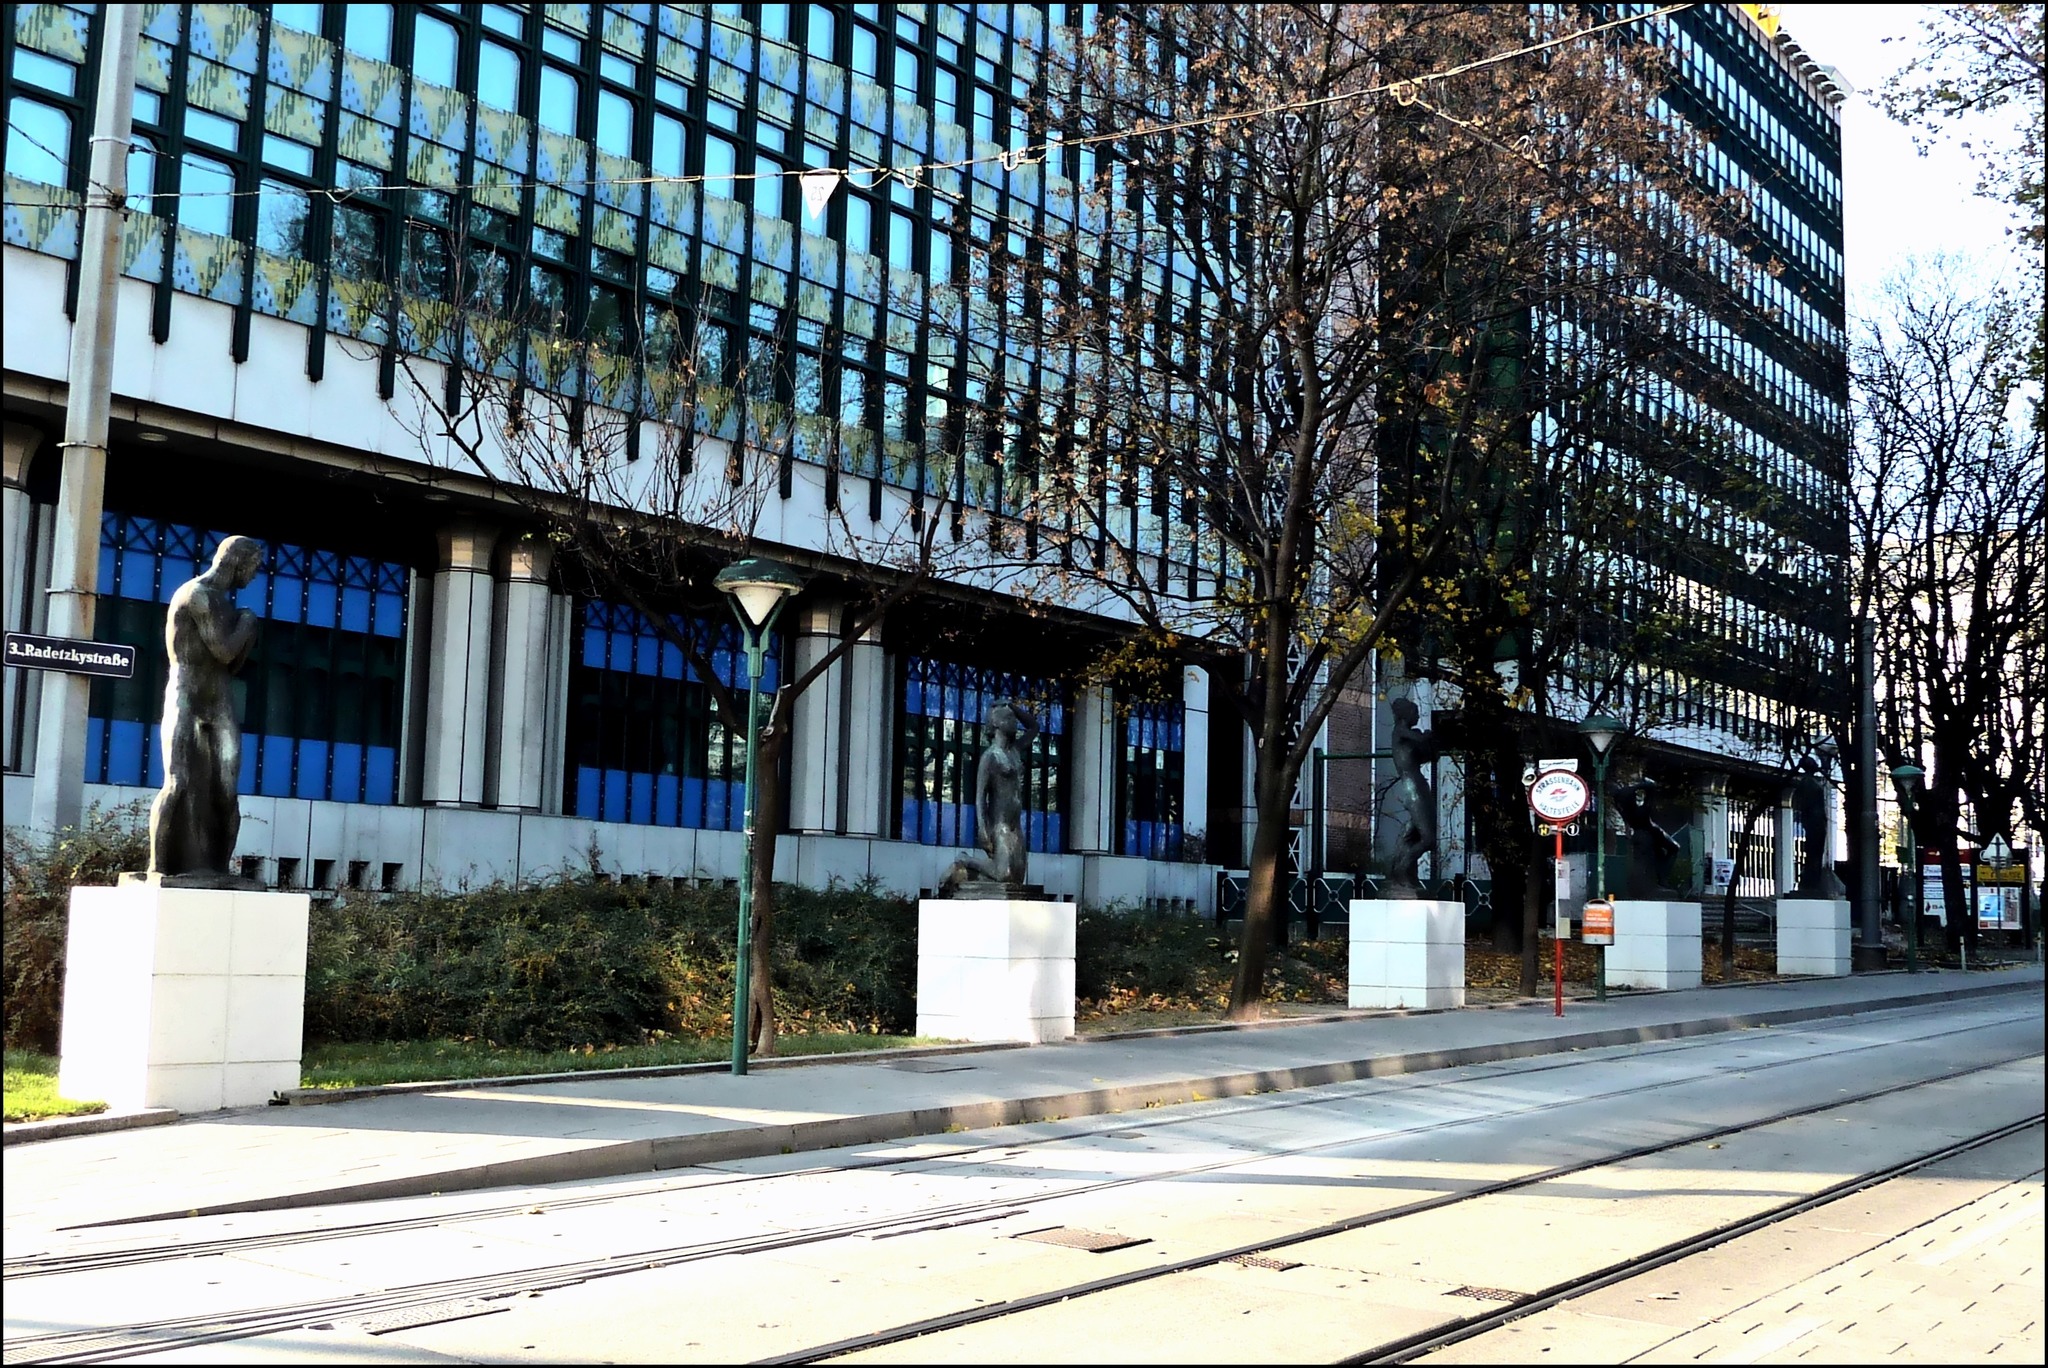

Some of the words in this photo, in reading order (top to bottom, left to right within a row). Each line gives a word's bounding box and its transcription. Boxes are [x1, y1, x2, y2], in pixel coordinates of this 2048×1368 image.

[1536, 776, 1581, 794] STRASSENBAHN
[1539, 801, 1580, 816] HALTESTELLE
[1569, 825, 1576, 835] 1
